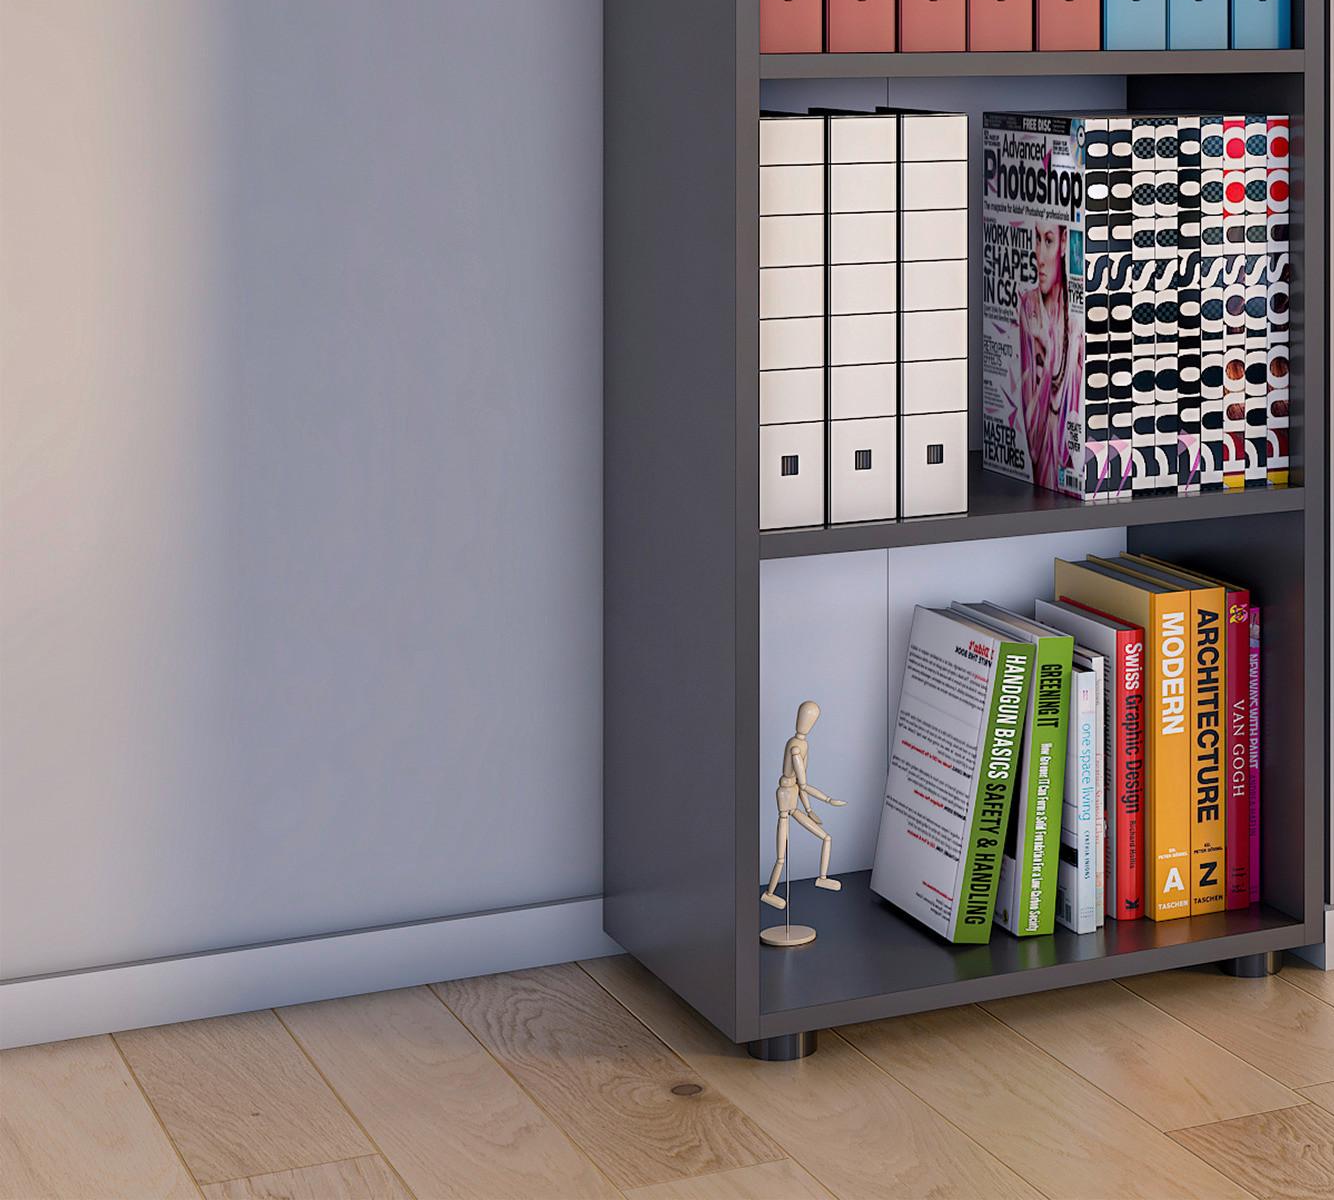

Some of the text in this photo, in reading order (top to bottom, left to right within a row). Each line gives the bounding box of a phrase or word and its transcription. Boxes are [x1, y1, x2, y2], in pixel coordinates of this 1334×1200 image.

[1023, 117, 1037, 131] FREE
[1037, 118, 1052, 132] DISC
[1002, 133, 1046, 161] Advanced
[984, 148, 1083, 222] Photoshop
[984, 223, 1032, 250] WORK WITH
[984, 244, 1038, 284] SHAPES
[984, 276, 1018, 308] IN CS6
[1069, 289, 1084, 305] TYPE
[984, 421, 1016, 447] MASTER
[984, 440, 1025, 470] TEXTURES
[1162, 611, 1185, 735] MODERN
[1037, 664, 1063, 728] GREENING IT
[1120, 642, 1143, 814] Swiss Graphic Design
[1197, 608, 1220, 823] ARCHITECTURE
[1249, 708, 1259, 737] WITH
[1232, 699, 1245, 797] VAN GOGH
[1249, 737, 1259, 769] PAINT
[1078, 722, 1095, 821] one space living
[964, 654, 1027, 925] HANDGUN BASICS SAFETY & HANDLING
[1163, 867, 1185, 894] A
[1199, 861, 1218, 888] N
[1157, 899, 1189, 911] TASCHEN
[1193, 895, 1223, 905] TASCHEN
